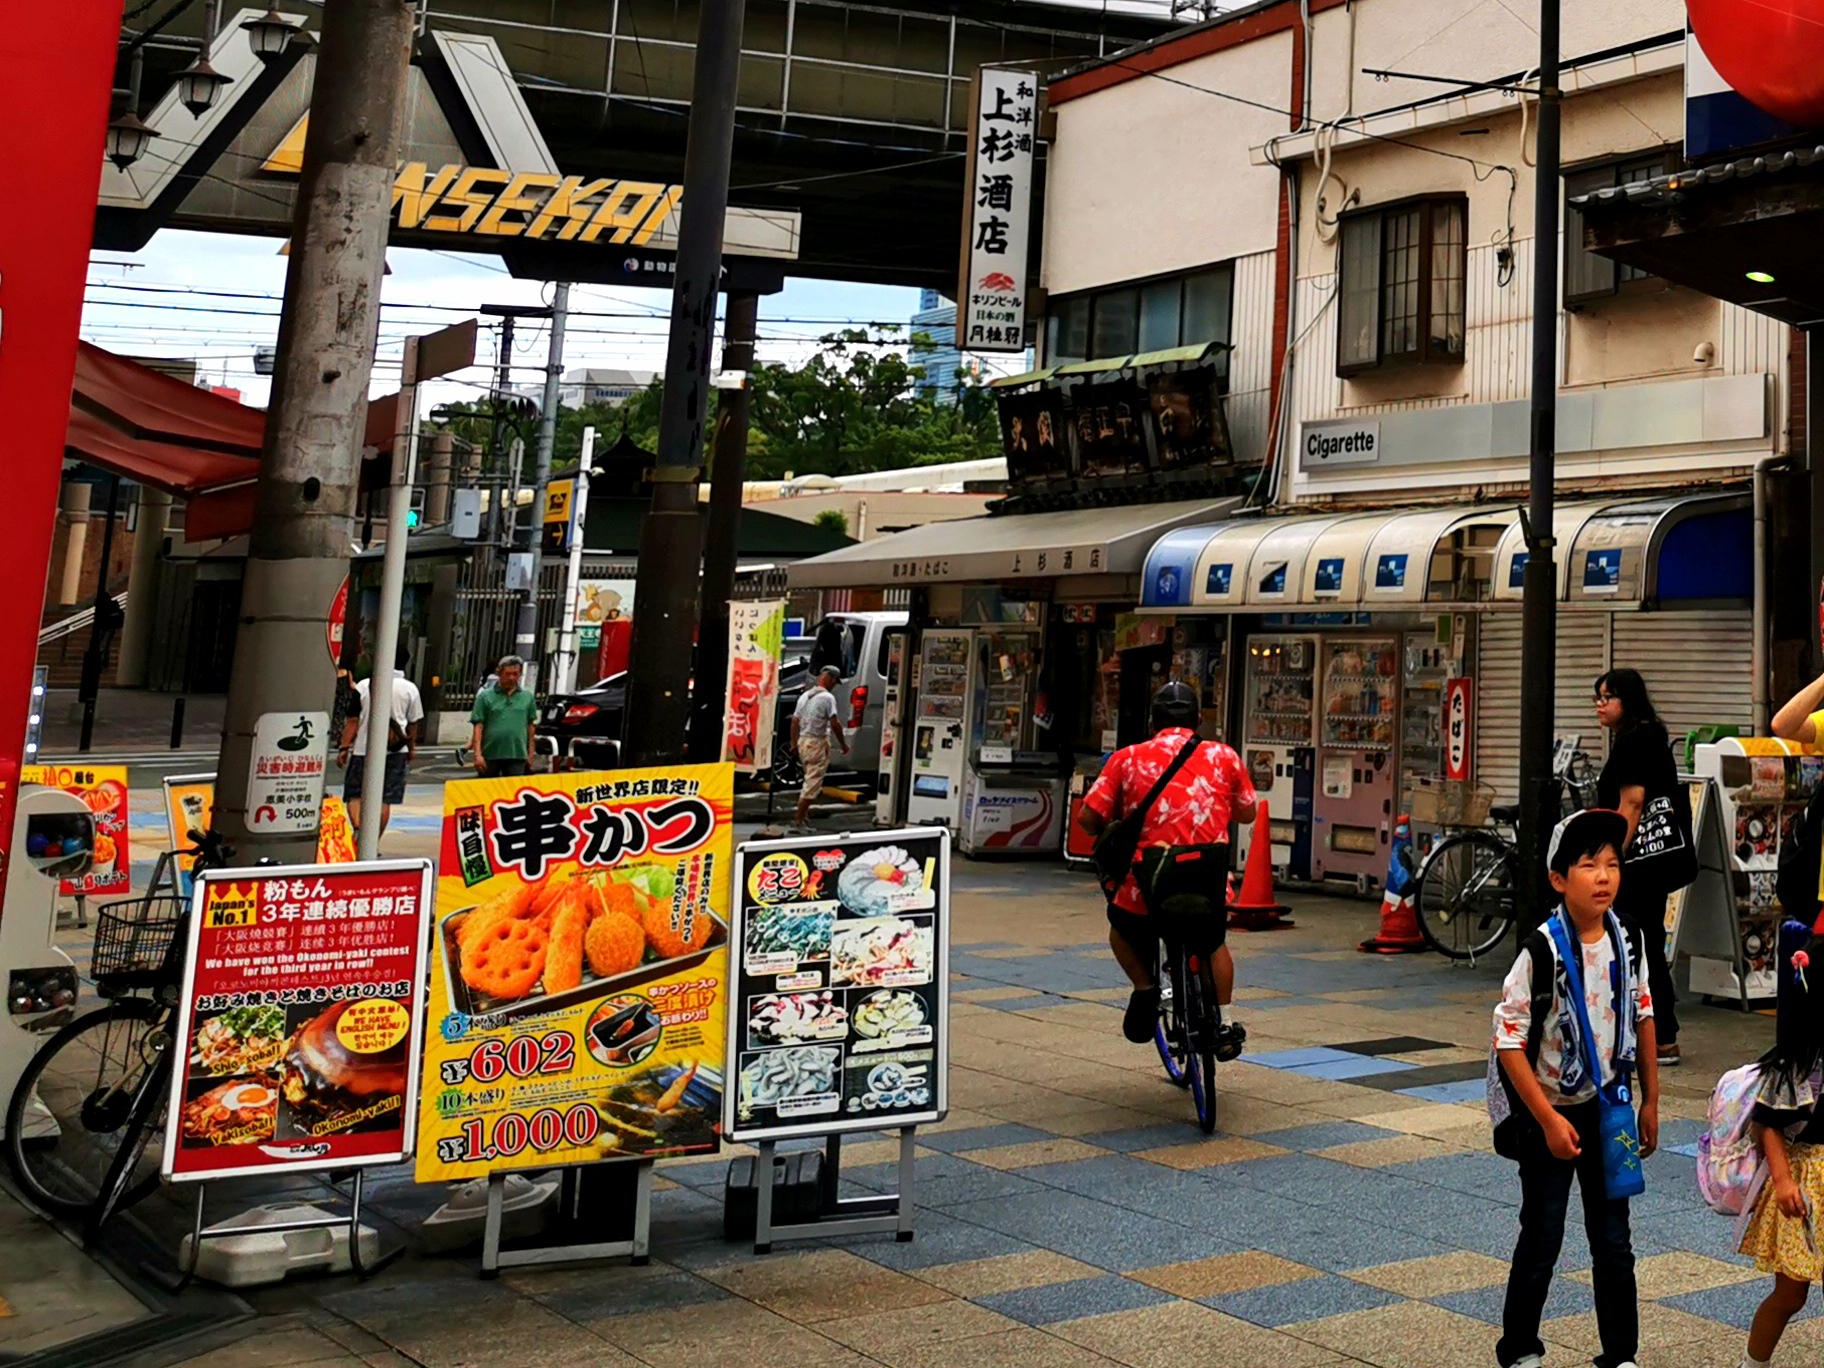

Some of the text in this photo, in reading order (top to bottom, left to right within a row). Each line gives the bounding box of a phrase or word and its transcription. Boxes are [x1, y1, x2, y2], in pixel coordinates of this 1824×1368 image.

[1014, 81, 1034, 153] 和洋酒
[975, 88, 1016, 255] 上杉酒店
[391, 160, 684, 246] NSEKAI
[972, 295, 1021, 308] キリンビール
[976, 310, 1015, 323] 日本の酒
[969, 325, 1020, 344] 月桂冠
[1307, 430, 1374, 459] Cigarette
[1012, 549, 1100, 574] 上杉酒店
[1451, 693, 1462, 763] たばこ
[256, 761, 323, 774] 災害時避難所
[576, 779, 699, 805] 新世界店限定!!
[286, 808, 316, 819] 500m
[493, 793, 712, 877] 串かつ
[264, 878, 332, 902] 粉もん
[757, 868, 802, 889] たこ
[209, 898, 255, 912] Japan's
[262, 896, 417, 923] 3年連続優勝店
[212, 910, 248, 926] No.1
[205, 946, 409, 969] We have won the Okonomi-yaki contest
[243, 966, 260, 977] for
[261, 965, 278, 976] the
[281, 963, 307, 974] third
[309, 962, 333, 974] year
[335, 961, 345, 970] in
[196, 981, 411, 1011] お好み焼きと焼きそばのお店
[648, 979, 716, 998] 串かつソースの
[441, 1030, 575, 1084] ¥602
